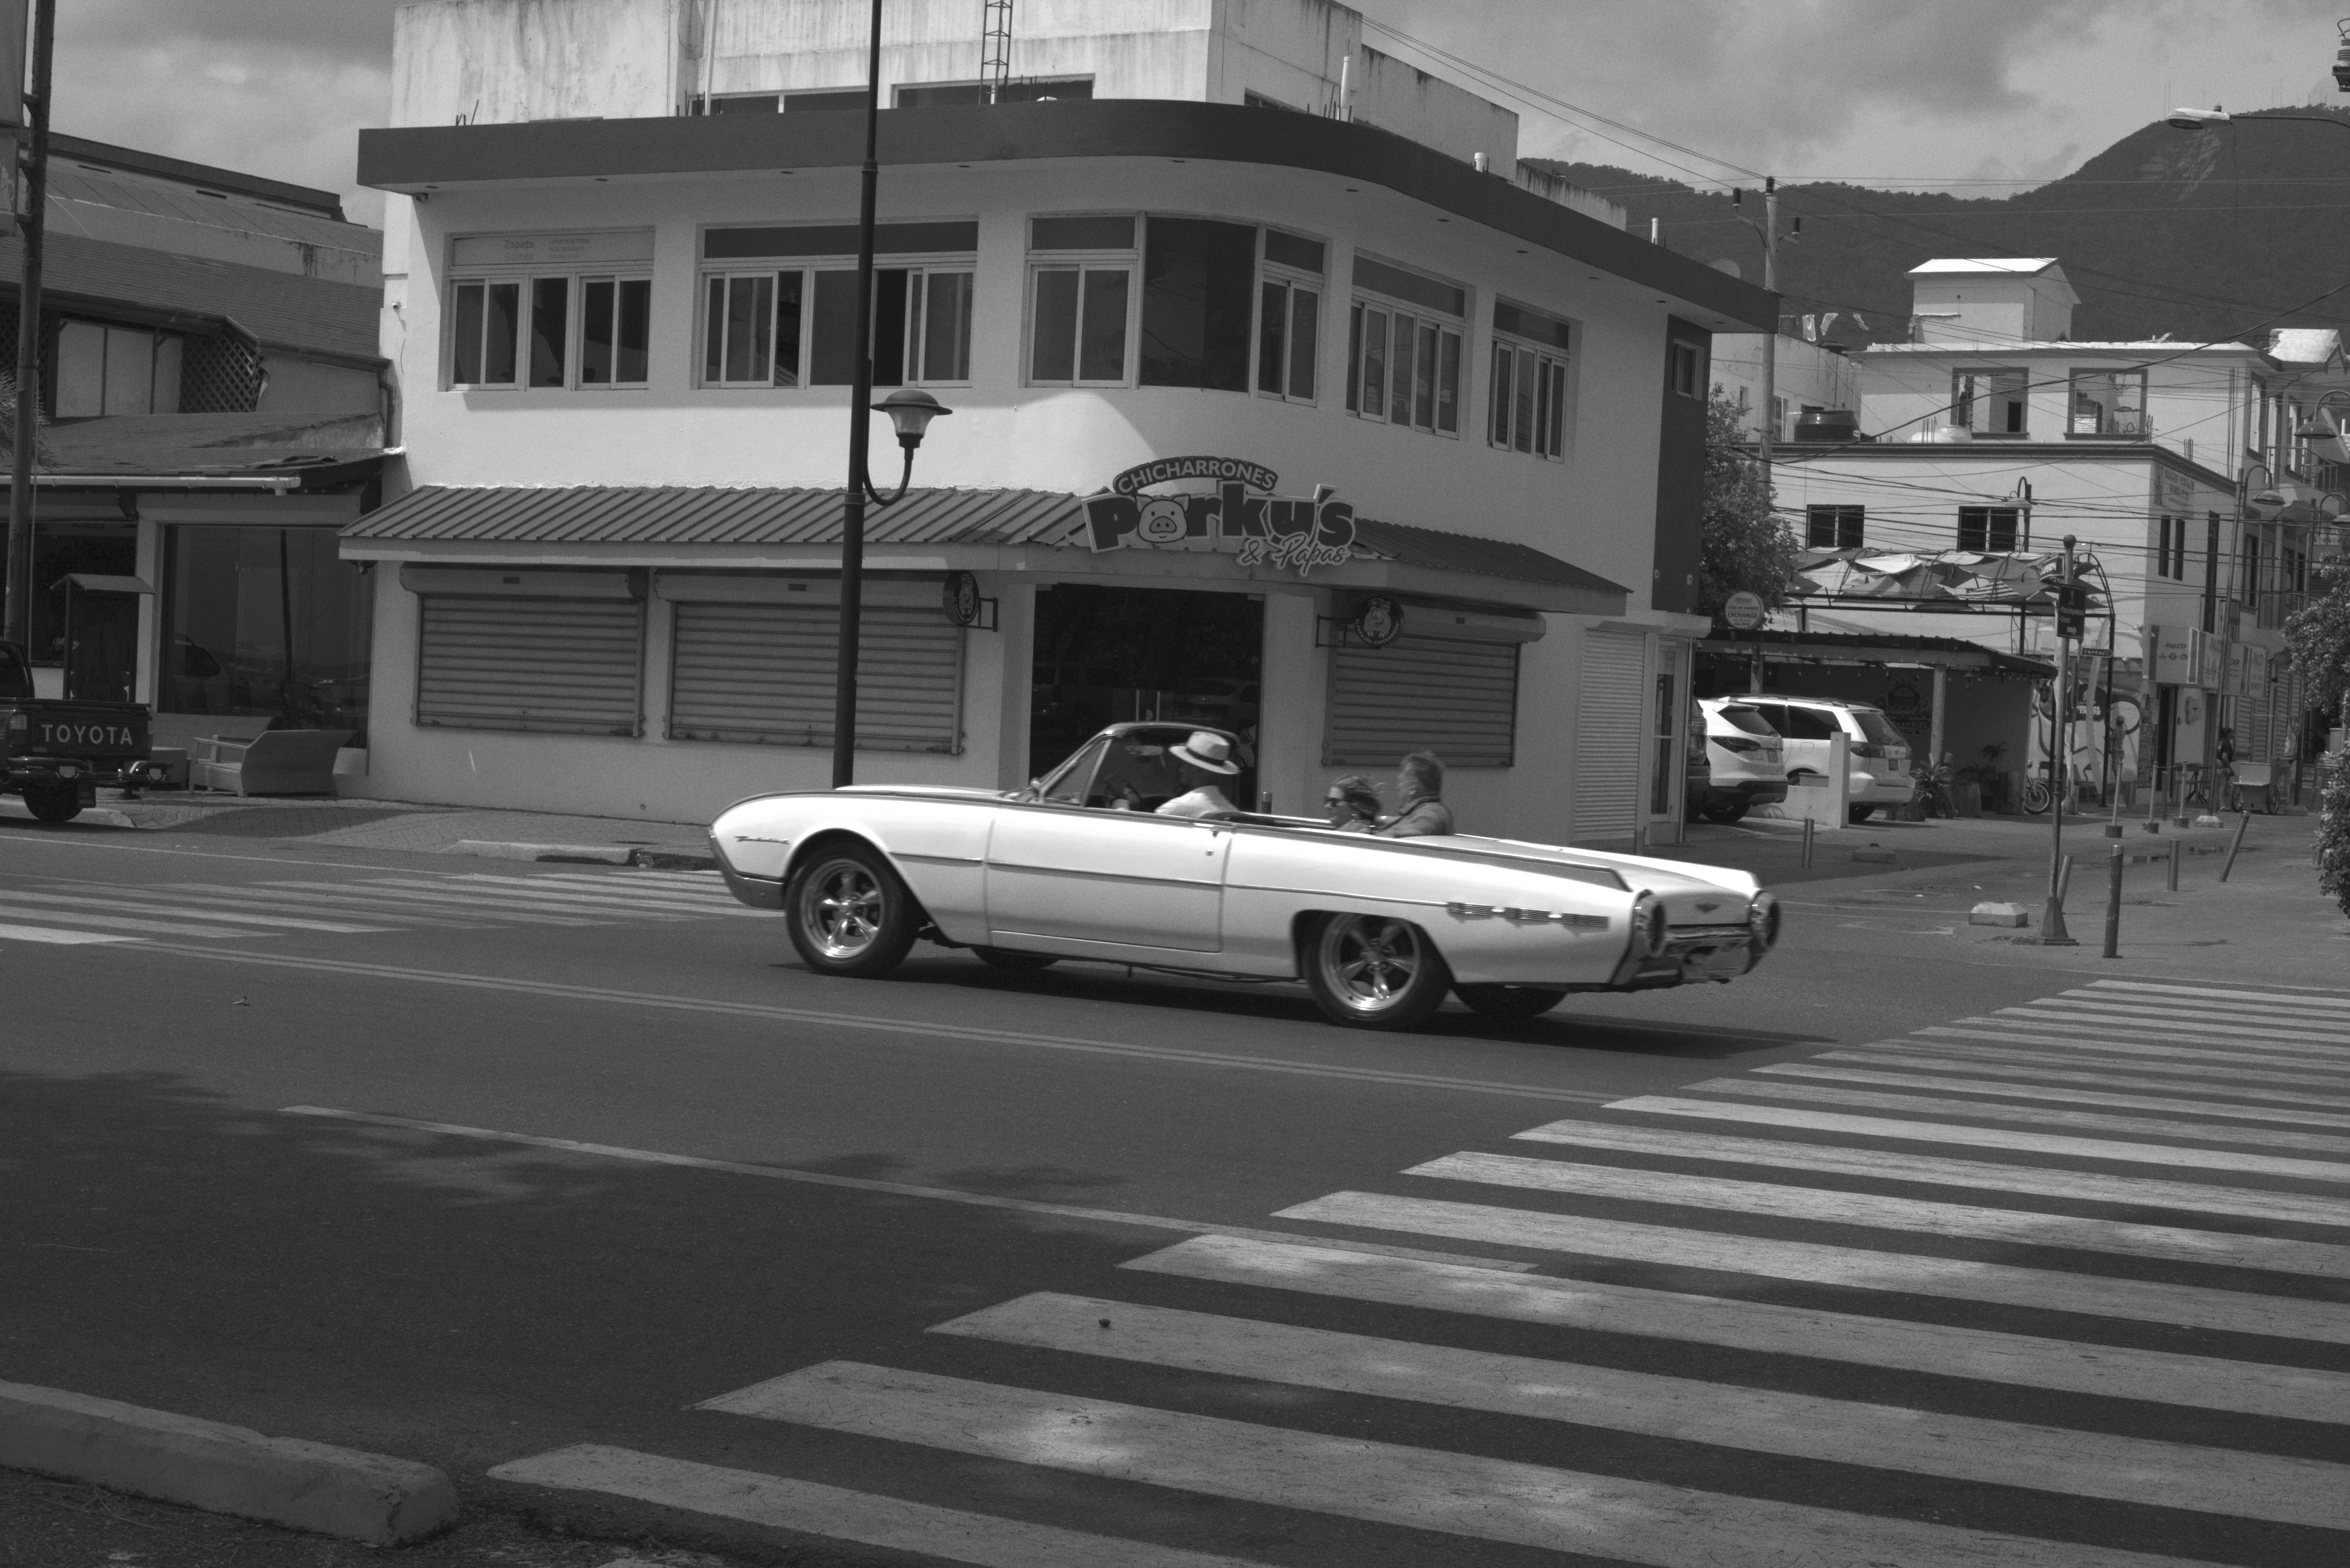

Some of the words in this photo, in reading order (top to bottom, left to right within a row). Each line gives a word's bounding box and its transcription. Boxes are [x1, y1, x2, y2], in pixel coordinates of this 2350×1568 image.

[505, 240, 534, 250] Zapata
[1117, 459, 1277, 493] CHICHARRONES
[1240, 538, 1263, 565] &
[1273, 533, 1347, 575] Papas
[41, 724, 133, 746] TOYOTA
